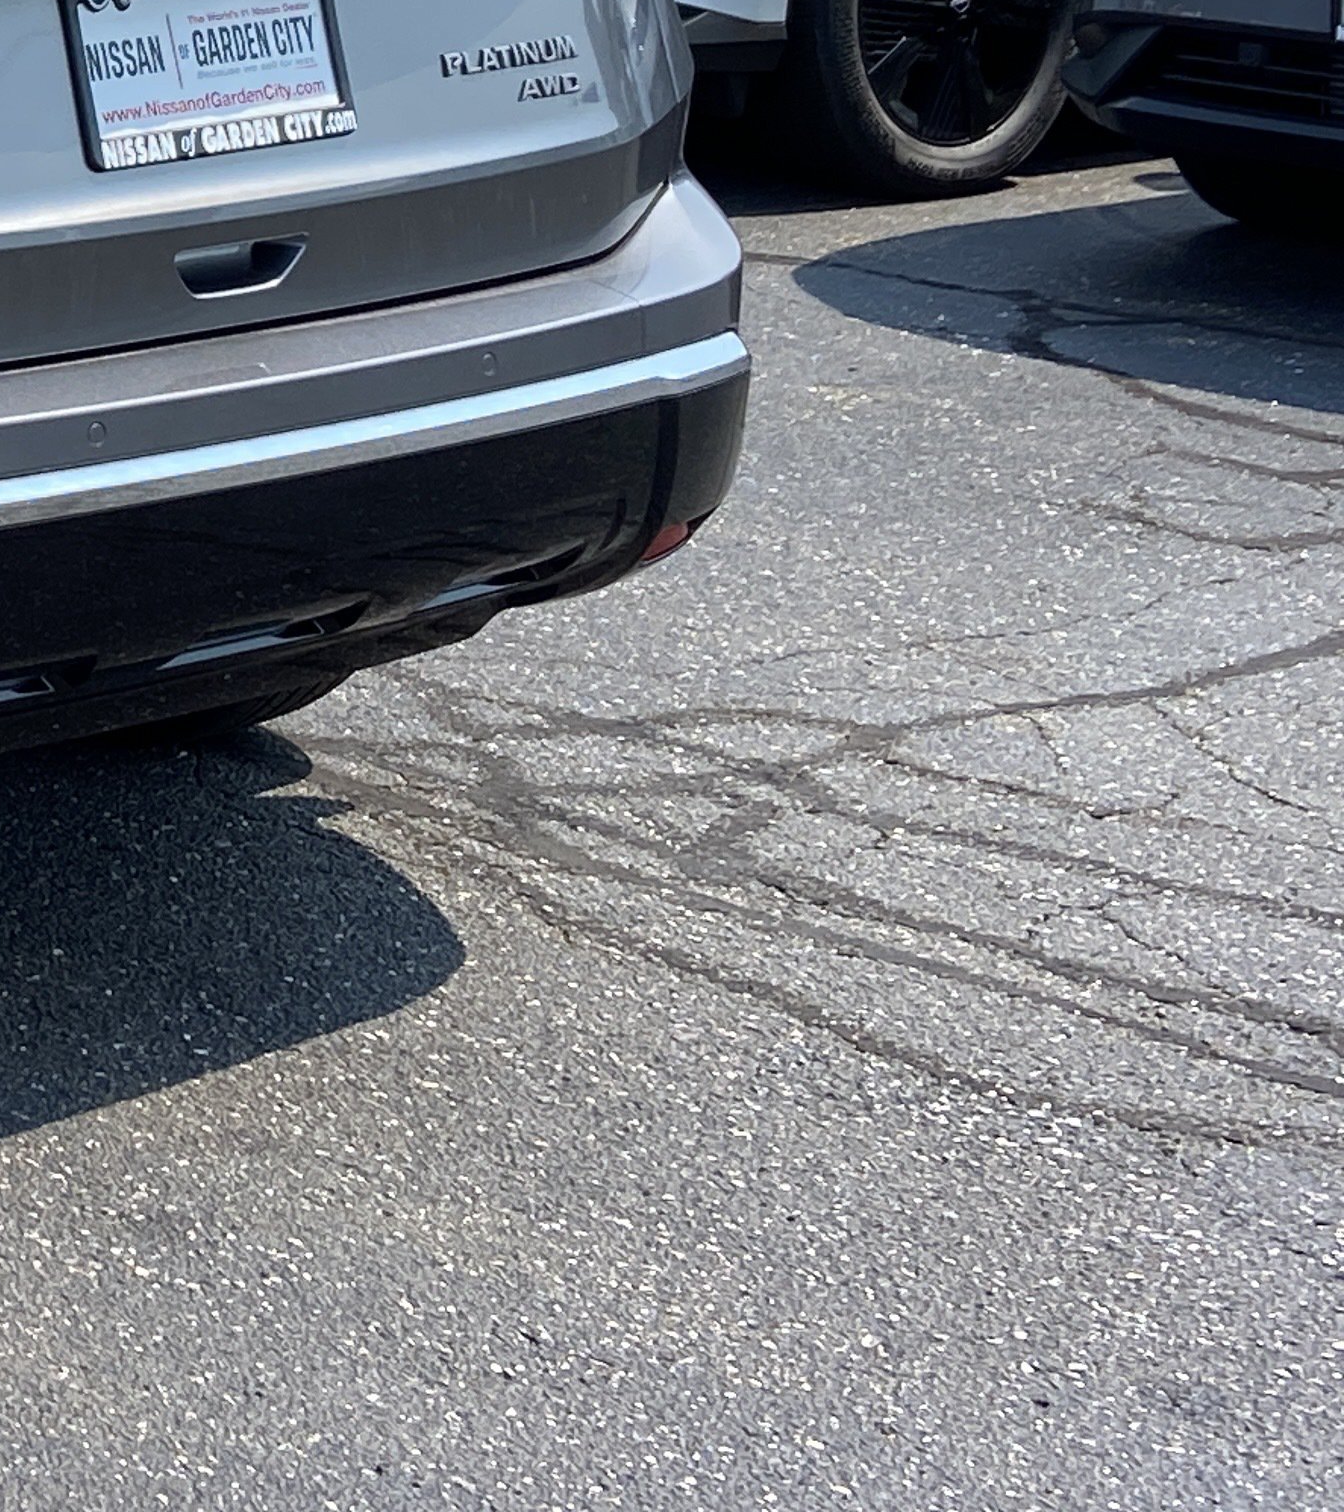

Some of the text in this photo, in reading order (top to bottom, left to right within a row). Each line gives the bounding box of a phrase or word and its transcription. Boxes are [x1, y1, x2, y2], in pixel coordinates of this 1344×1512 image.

[84, 34, 166, 81] NISSAN
[192, 21, 272, 67] GARDEN
[272, 14, 315, 56] CITY
[439, 34, 579, 78] PLATINUM
[102, 79, 327, 125] www.NissanofGardenCity.com
[517, 71, 581, 102] AWD
[100, 131, 178, 170] NISSAN
[180, 128, 198, 158] of
[200, 117, 281, 154] GARDEN
